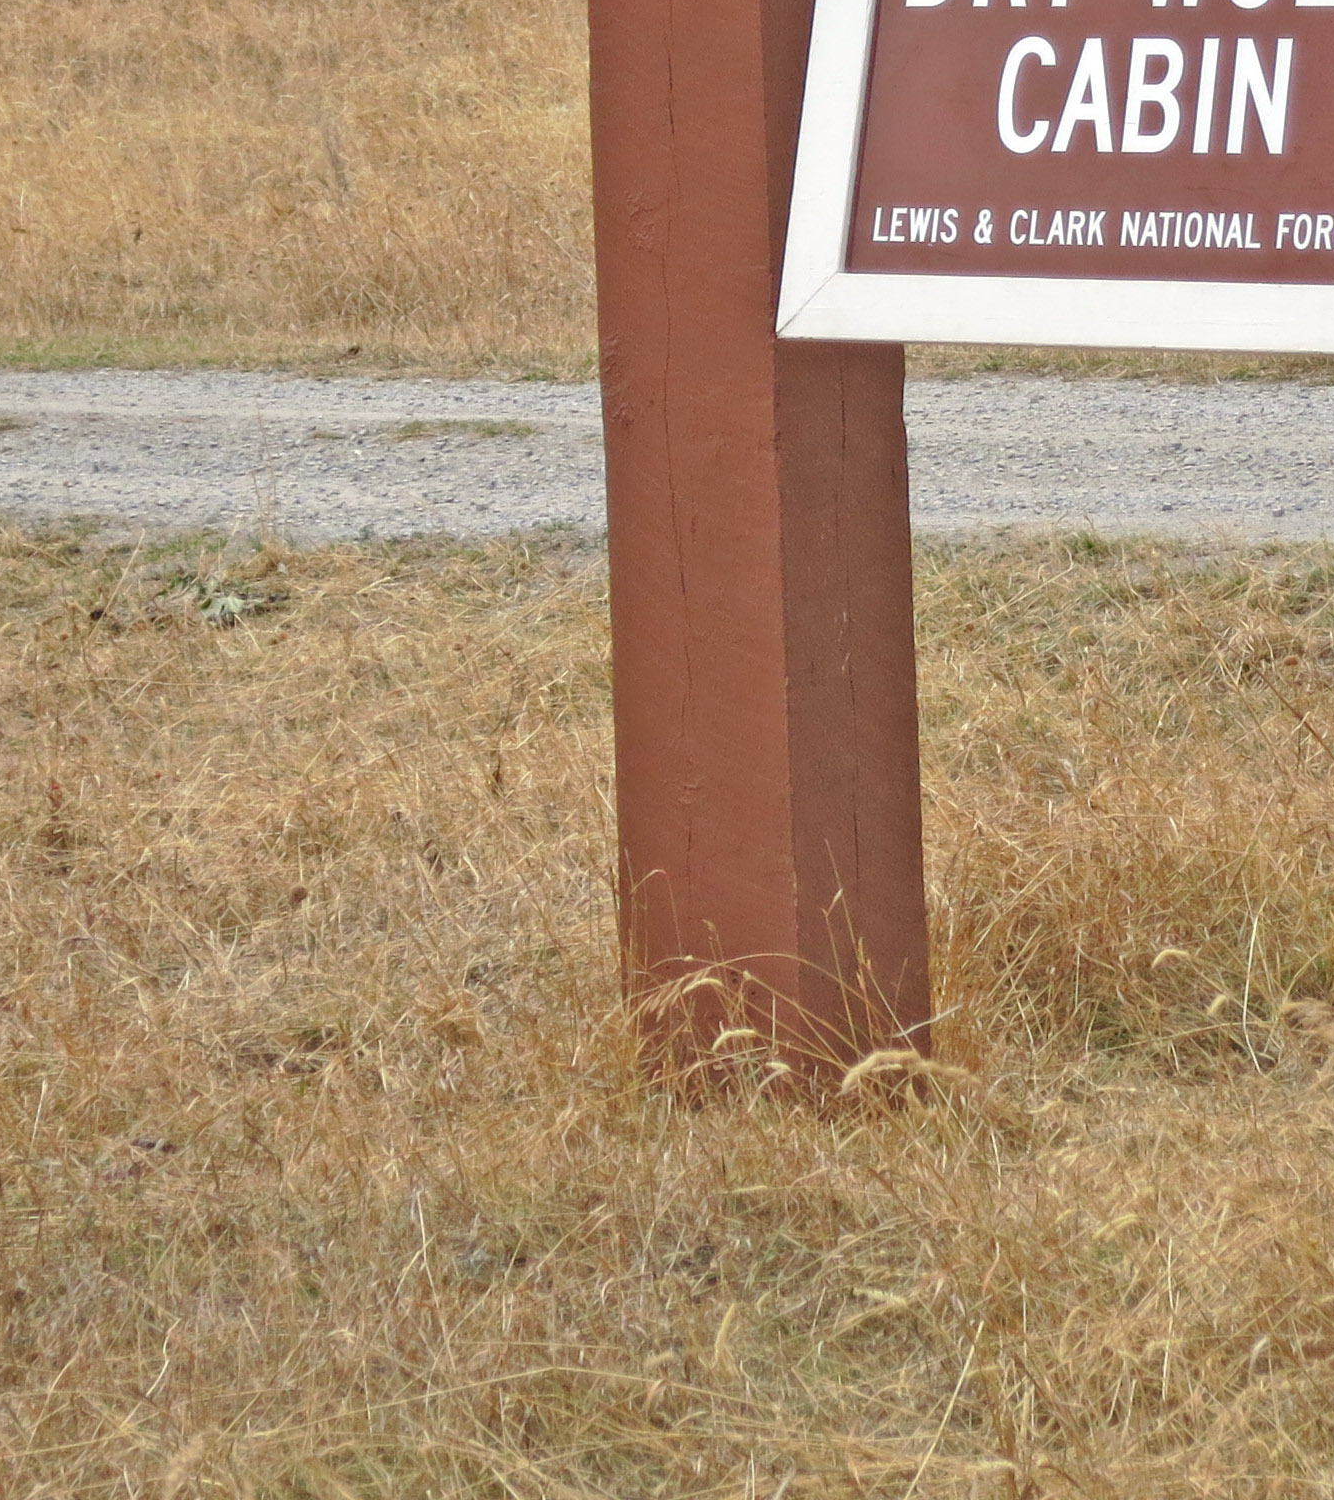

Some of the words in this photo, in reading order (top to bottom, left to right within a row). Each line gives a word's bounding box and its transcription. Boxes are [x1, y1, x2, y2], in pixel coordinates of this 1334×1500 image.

[997, 35, 1294, 155] CABIN
[872, 207, 959, 244] LEWIS
[973, 208, 994, 244] &
[1009, 209, 1107, 246] CLARK
[1120, 211, 1262, 249] NATIONAL
